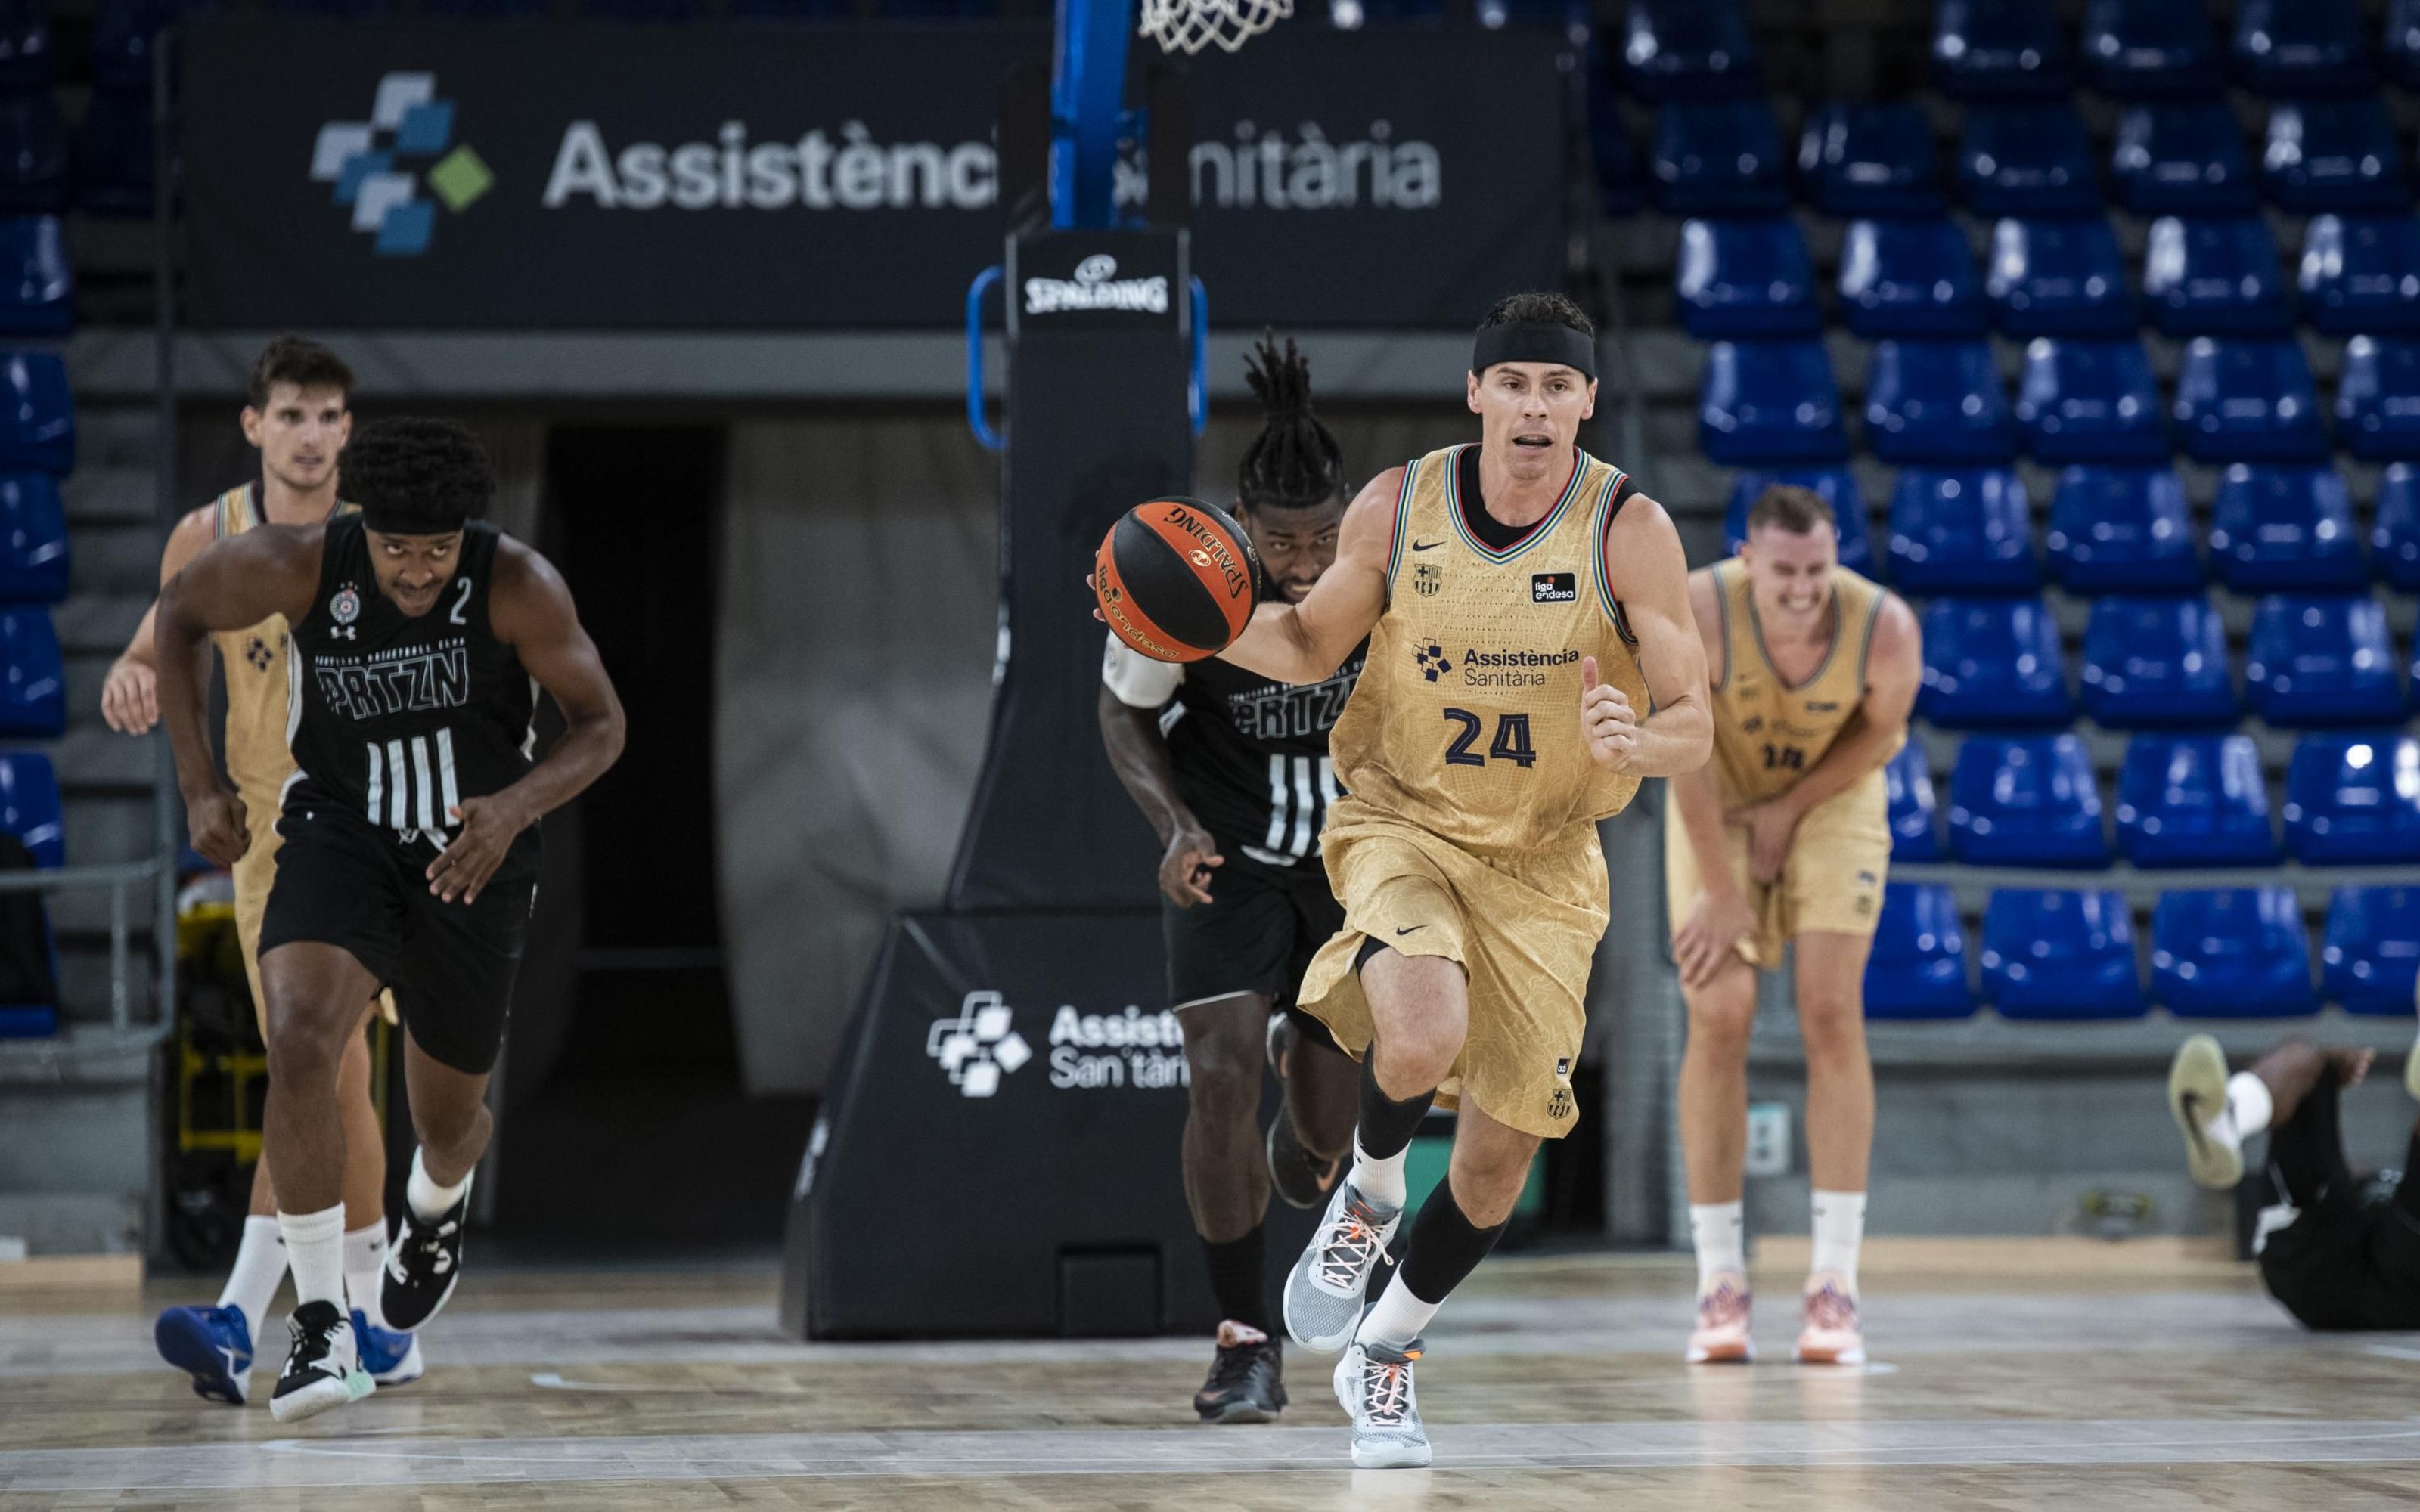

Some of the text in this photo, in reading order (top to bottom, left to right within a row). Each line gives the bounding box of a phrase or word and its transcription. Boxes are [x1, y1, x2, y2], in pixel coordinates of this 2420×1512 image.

[542, 119, 1441, 210] Assistènc nitària
[1163, 507, 1250, 600] SPALDING
[449, 576, 473, 626] 2
[1099, 564, 1181, 658] liga endesa
[1534, 581, 1553, 593] liga
[1535, 590, 1574, 600] endesa
[1463, 648, 1580, 667] Assistència
[1464, 668, 1547, 686] Sanitària
[1228, 671, 1361, 741] PRTZ
[1443, 707, 1537, 769] 24
[1049, 1005, 1185, 1048] Assist
